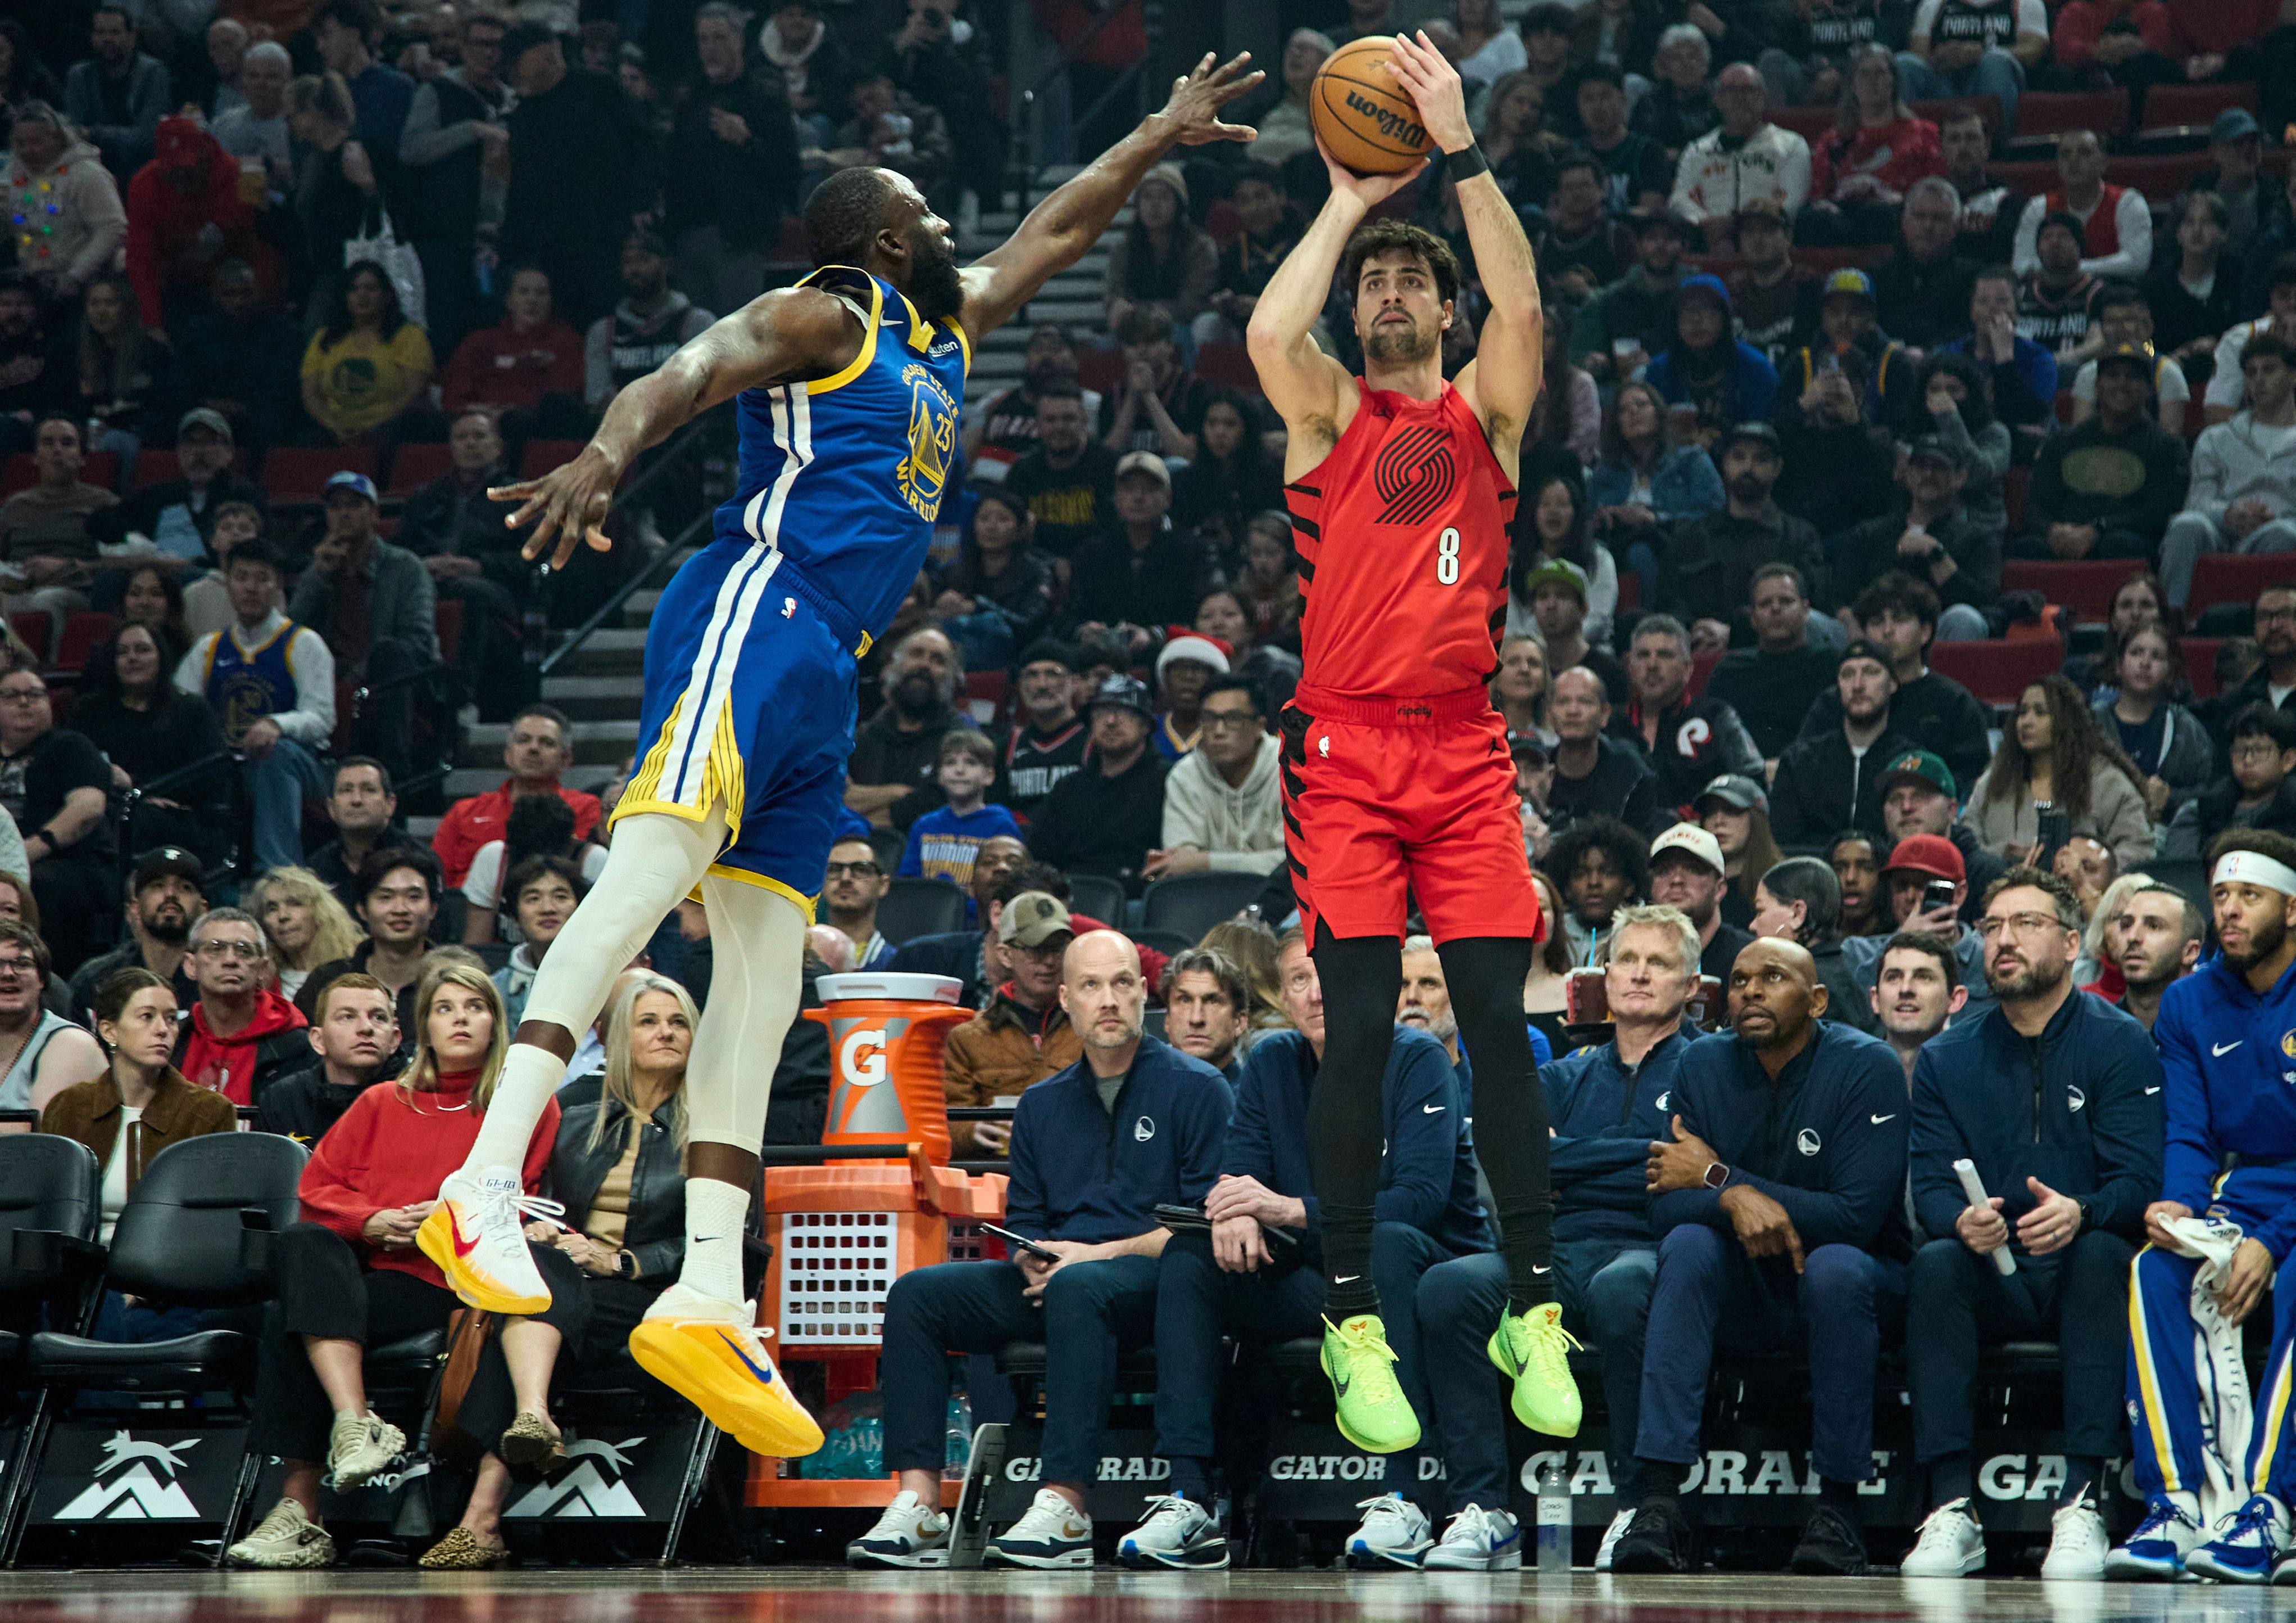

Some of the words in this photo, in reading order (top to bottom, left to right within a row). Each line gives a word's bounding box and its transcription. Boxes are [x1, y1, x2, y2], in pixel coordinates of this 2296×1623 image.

[1346, 89, 1428, 149] Wilson
[902, 364, 927, 386] GOLDEN
[929, 374, 959, 418] STATE
[934, 412, 952, 452] 23
[896, 455, 943, 517] WARRIO
[1436, 527, 1460, 586] 8
[1397, 704, 1432, 718] ripcity
[841, 1029, 887, 1086] G
[1269, 1456, 1448, 1480] GATORD
